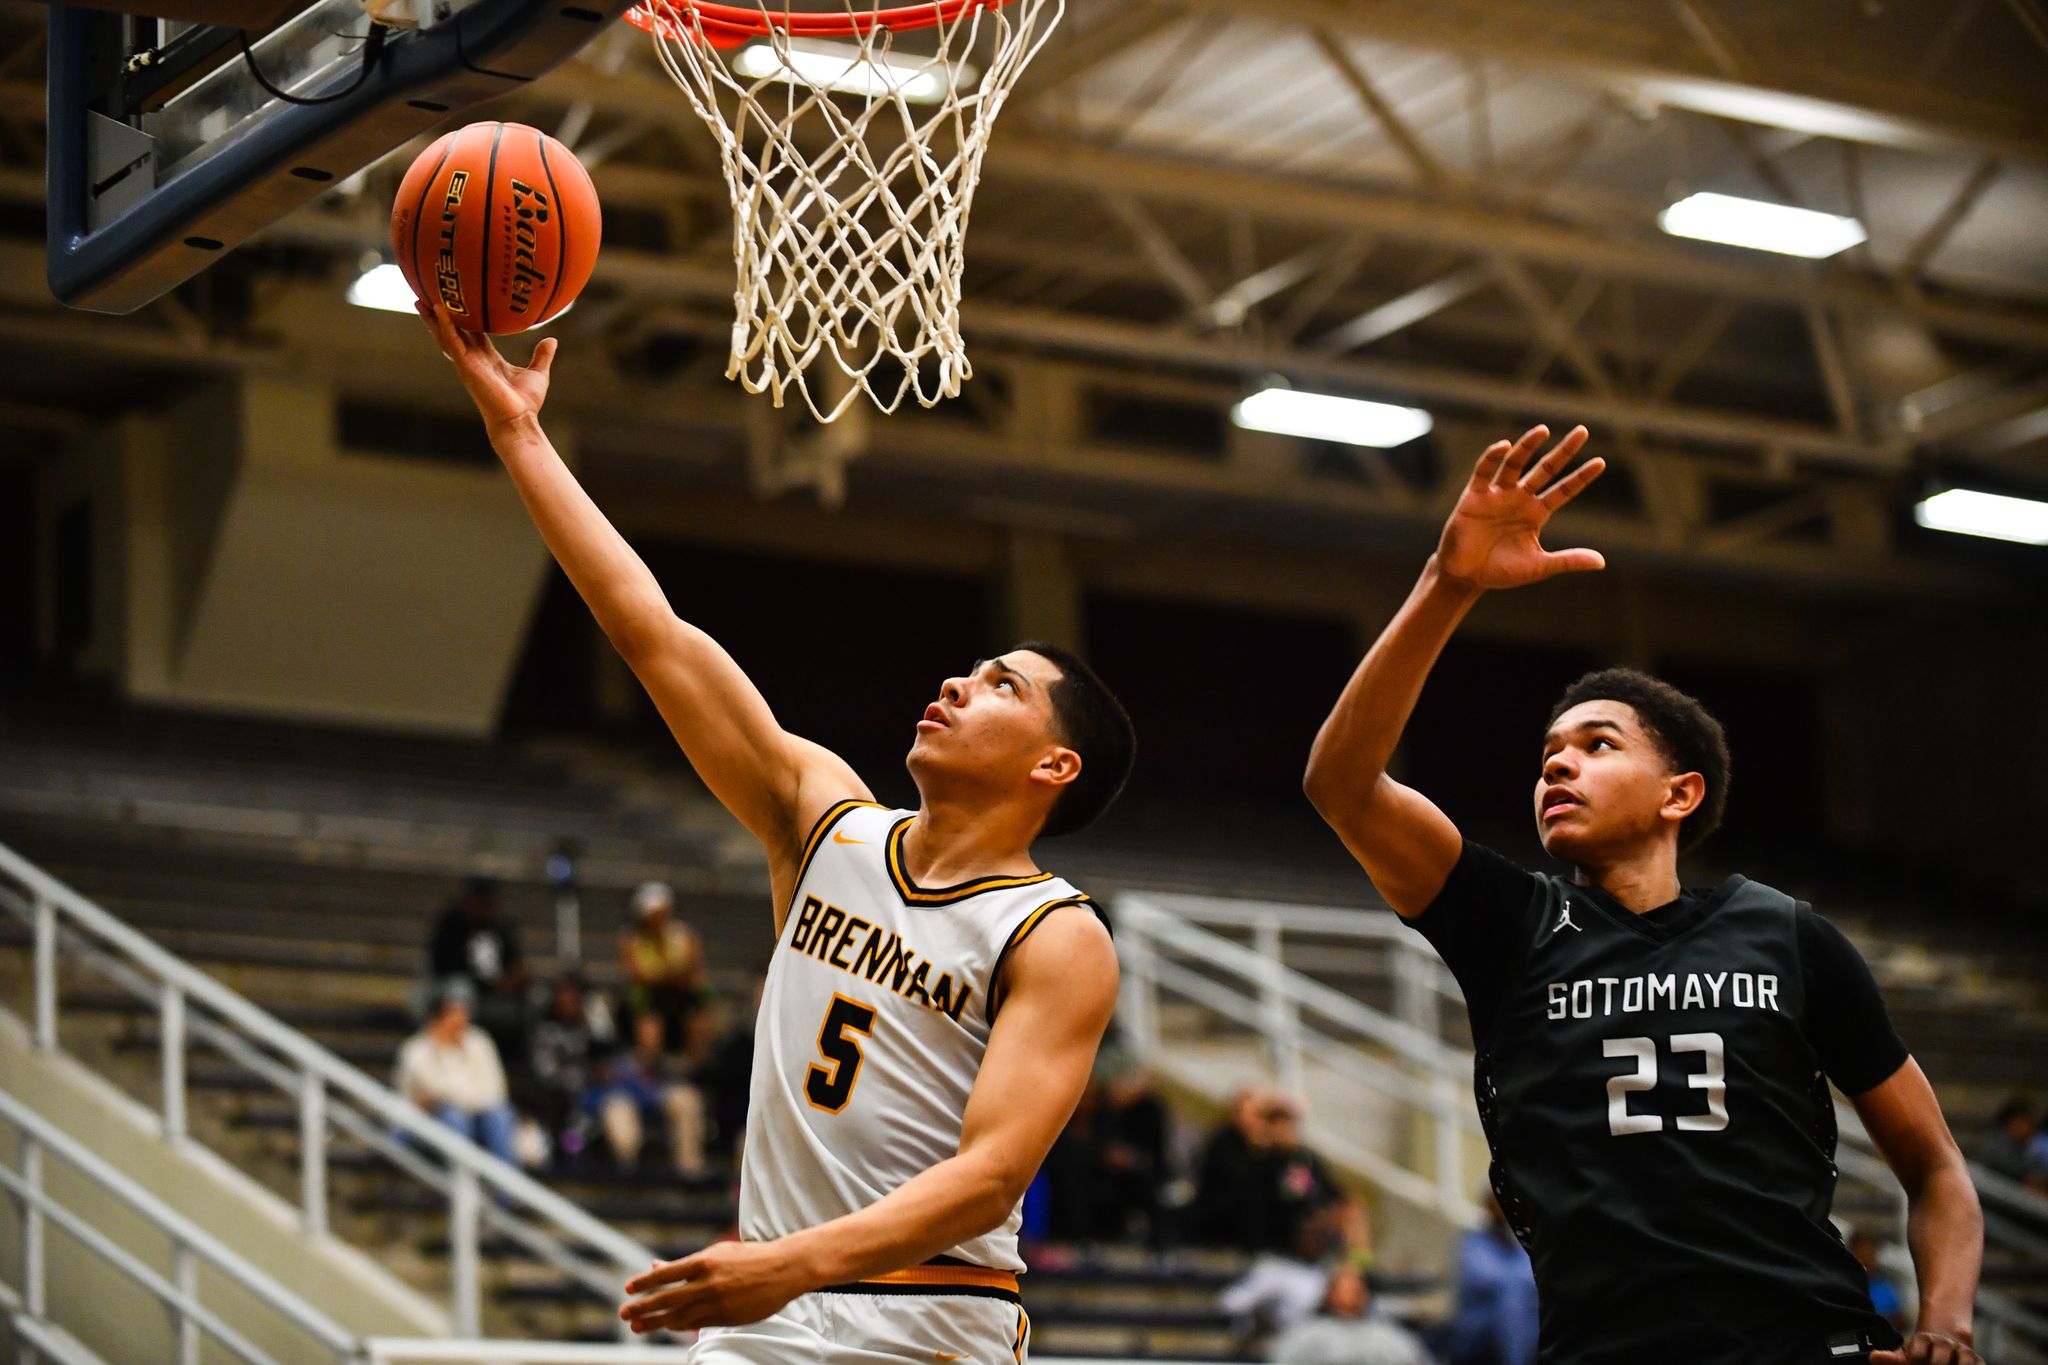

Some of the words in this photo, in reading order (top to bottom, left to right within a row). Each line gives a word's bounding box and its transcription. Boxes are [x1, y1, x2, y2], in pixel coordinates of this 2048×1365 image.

[509, 178, 549, 314] Baden
[790, 894, 973, 1024] BRENNAN
[1547, 971, 1780, 1020] SOTOMAYOR
[803, 991, 878, 1115] 5
[1602, 1032, 1729, 1136] 23
